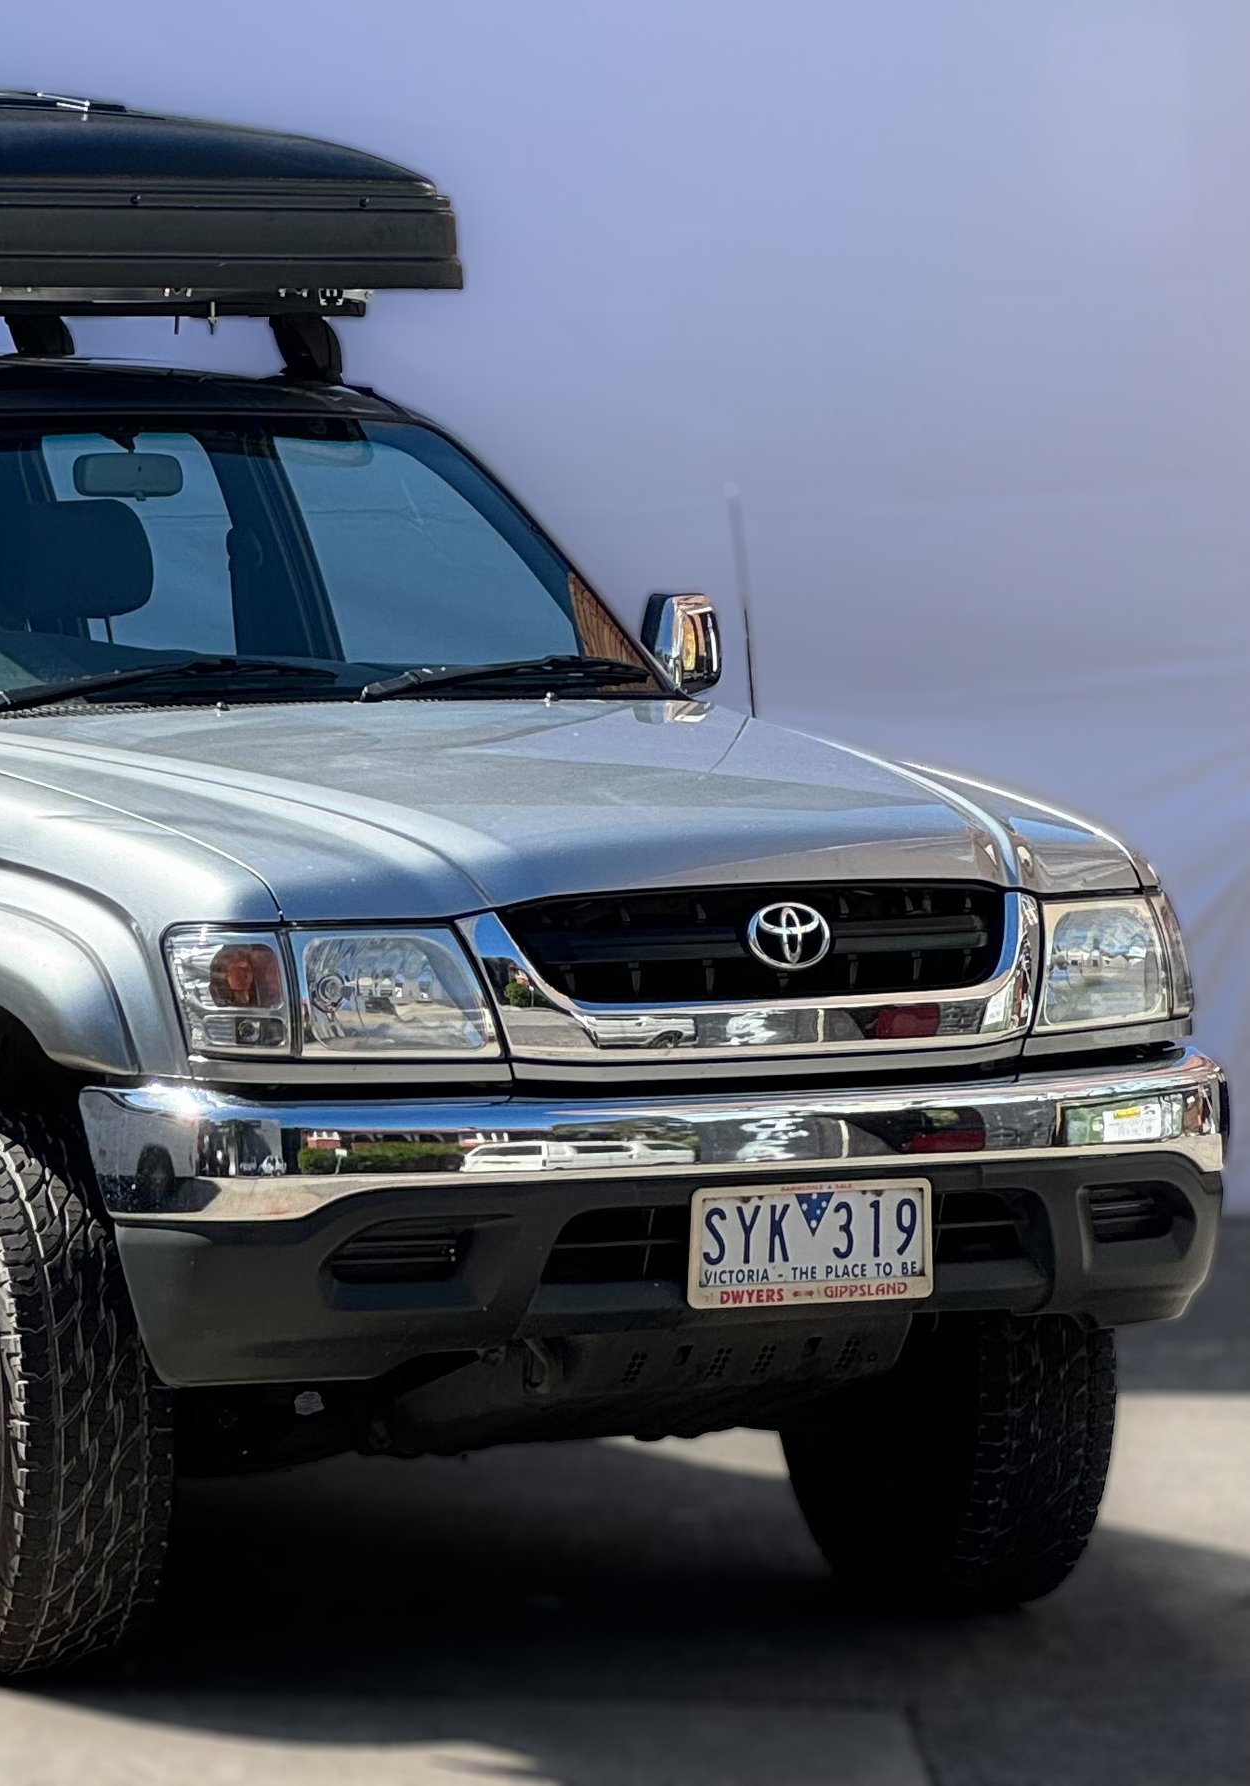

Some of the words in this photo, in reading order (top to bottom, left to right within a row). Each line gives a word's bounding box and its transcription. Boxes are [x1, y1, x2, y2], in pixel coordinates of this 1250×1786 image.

[703, 1204, 790, 1265] SYK
[833, 1199, 917, 1259] 319
[705, 1268, 770, 1285] VICTORIA
[791, 1265, 818, 1281] THE
[825, 1262, 868, 1279] PLACE
[875, 1261, 894, 1277] TO
[901, 1260, 918, 1276] BE
[720, 1288, 784, 1305] DWYERS
[824, 1282, 908, 1298] GIPPSLAND
